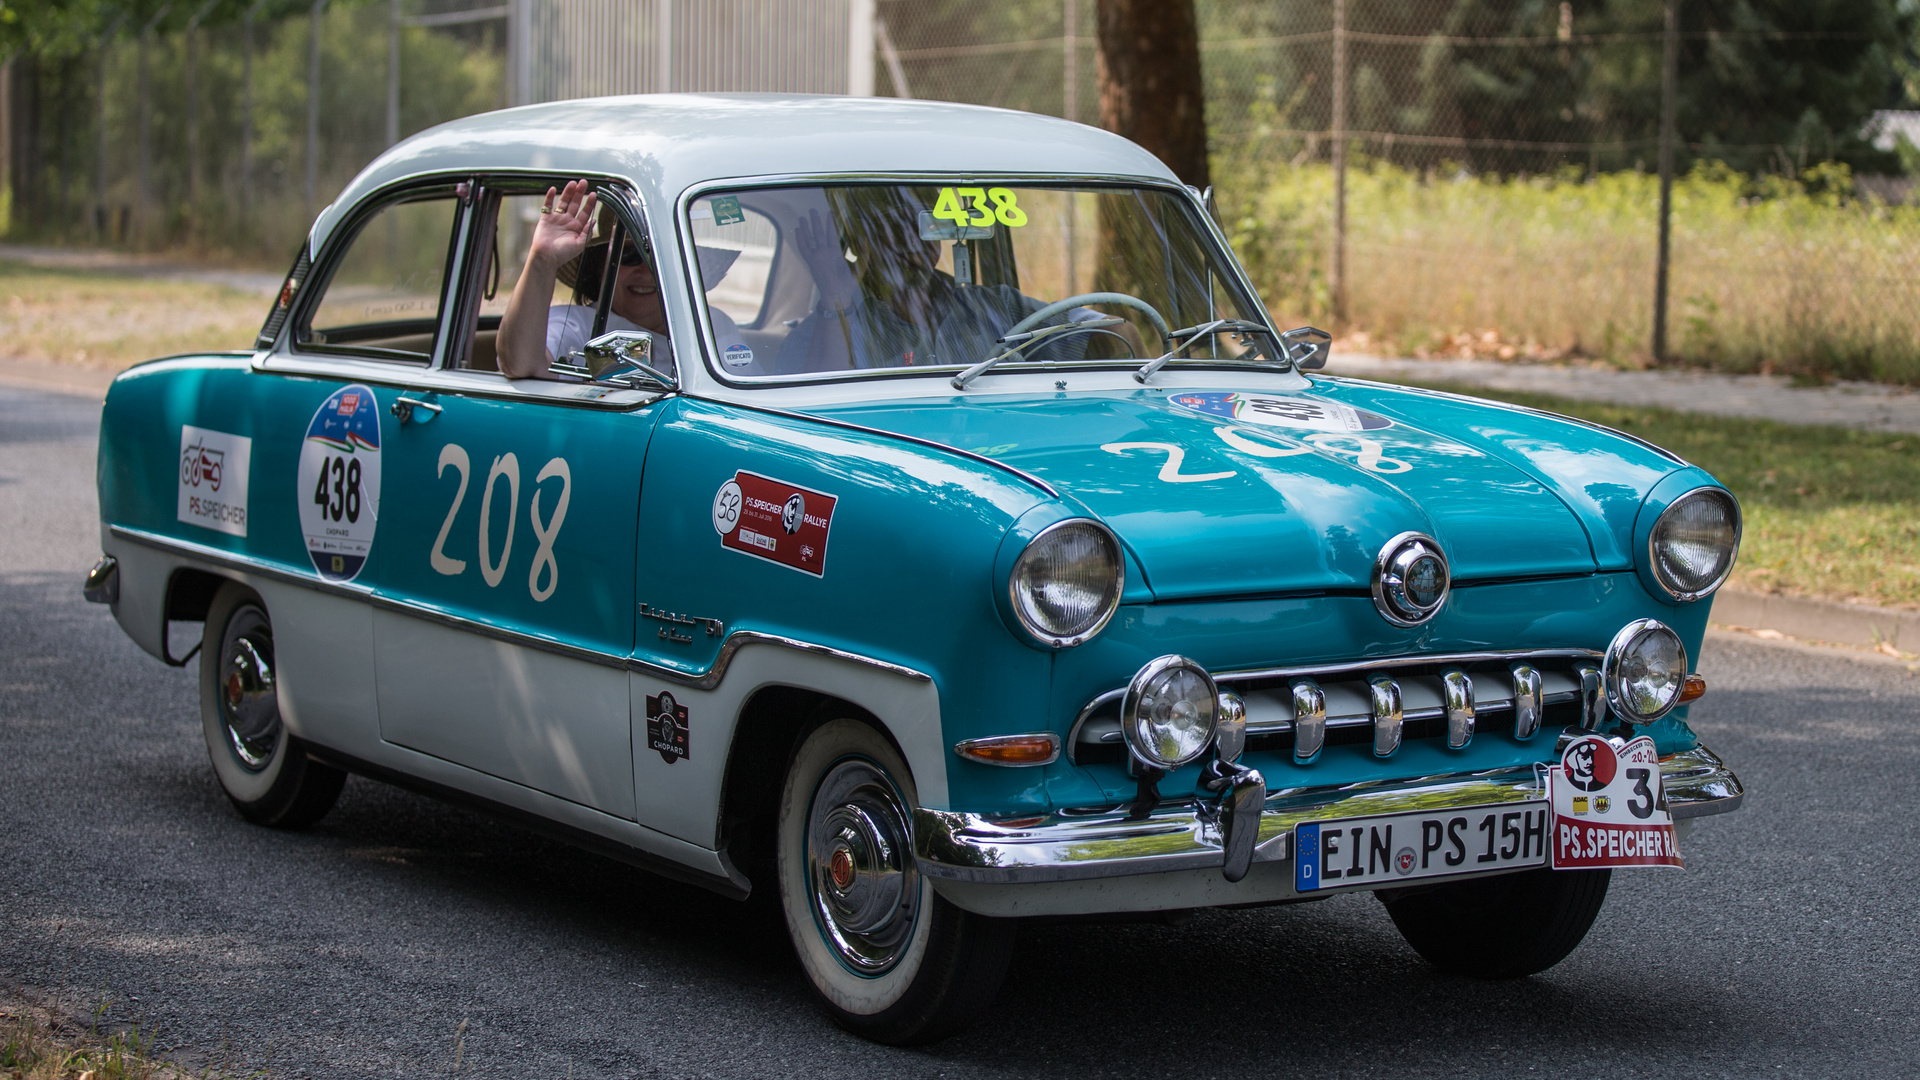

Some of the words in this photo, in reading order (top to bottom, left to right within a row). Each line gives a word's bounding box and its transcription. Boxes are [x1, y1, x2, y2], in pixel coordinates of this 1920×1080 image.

[933, 187, 1028, 228] 438
[726, 353, 751, 361] VERIFICATO
[1250, 399, 1325, 421] 438
[1100, 426, 1414, 483] 208
[314, 456, 361, 524] 438
[189, 496, 246, 526] PS.SPEICHER
[430, 443, 571, 602] 208
[745, 496, 783, 515] PS.SPEICHER
[803, 513, 828, 529] RALLYE
[325, 528, 349, 537] CHOPARD
[653, 740, 684, 755] CHOPARD
[1321, 824, 1392, 880] EIN
[1421, 817, 1468, 869] PS
[1477, 809, 1546, 864] 15H
[1560, 823, 1664, 860] PS.SPEICHER
[1303, 864, 1313, 879] D
